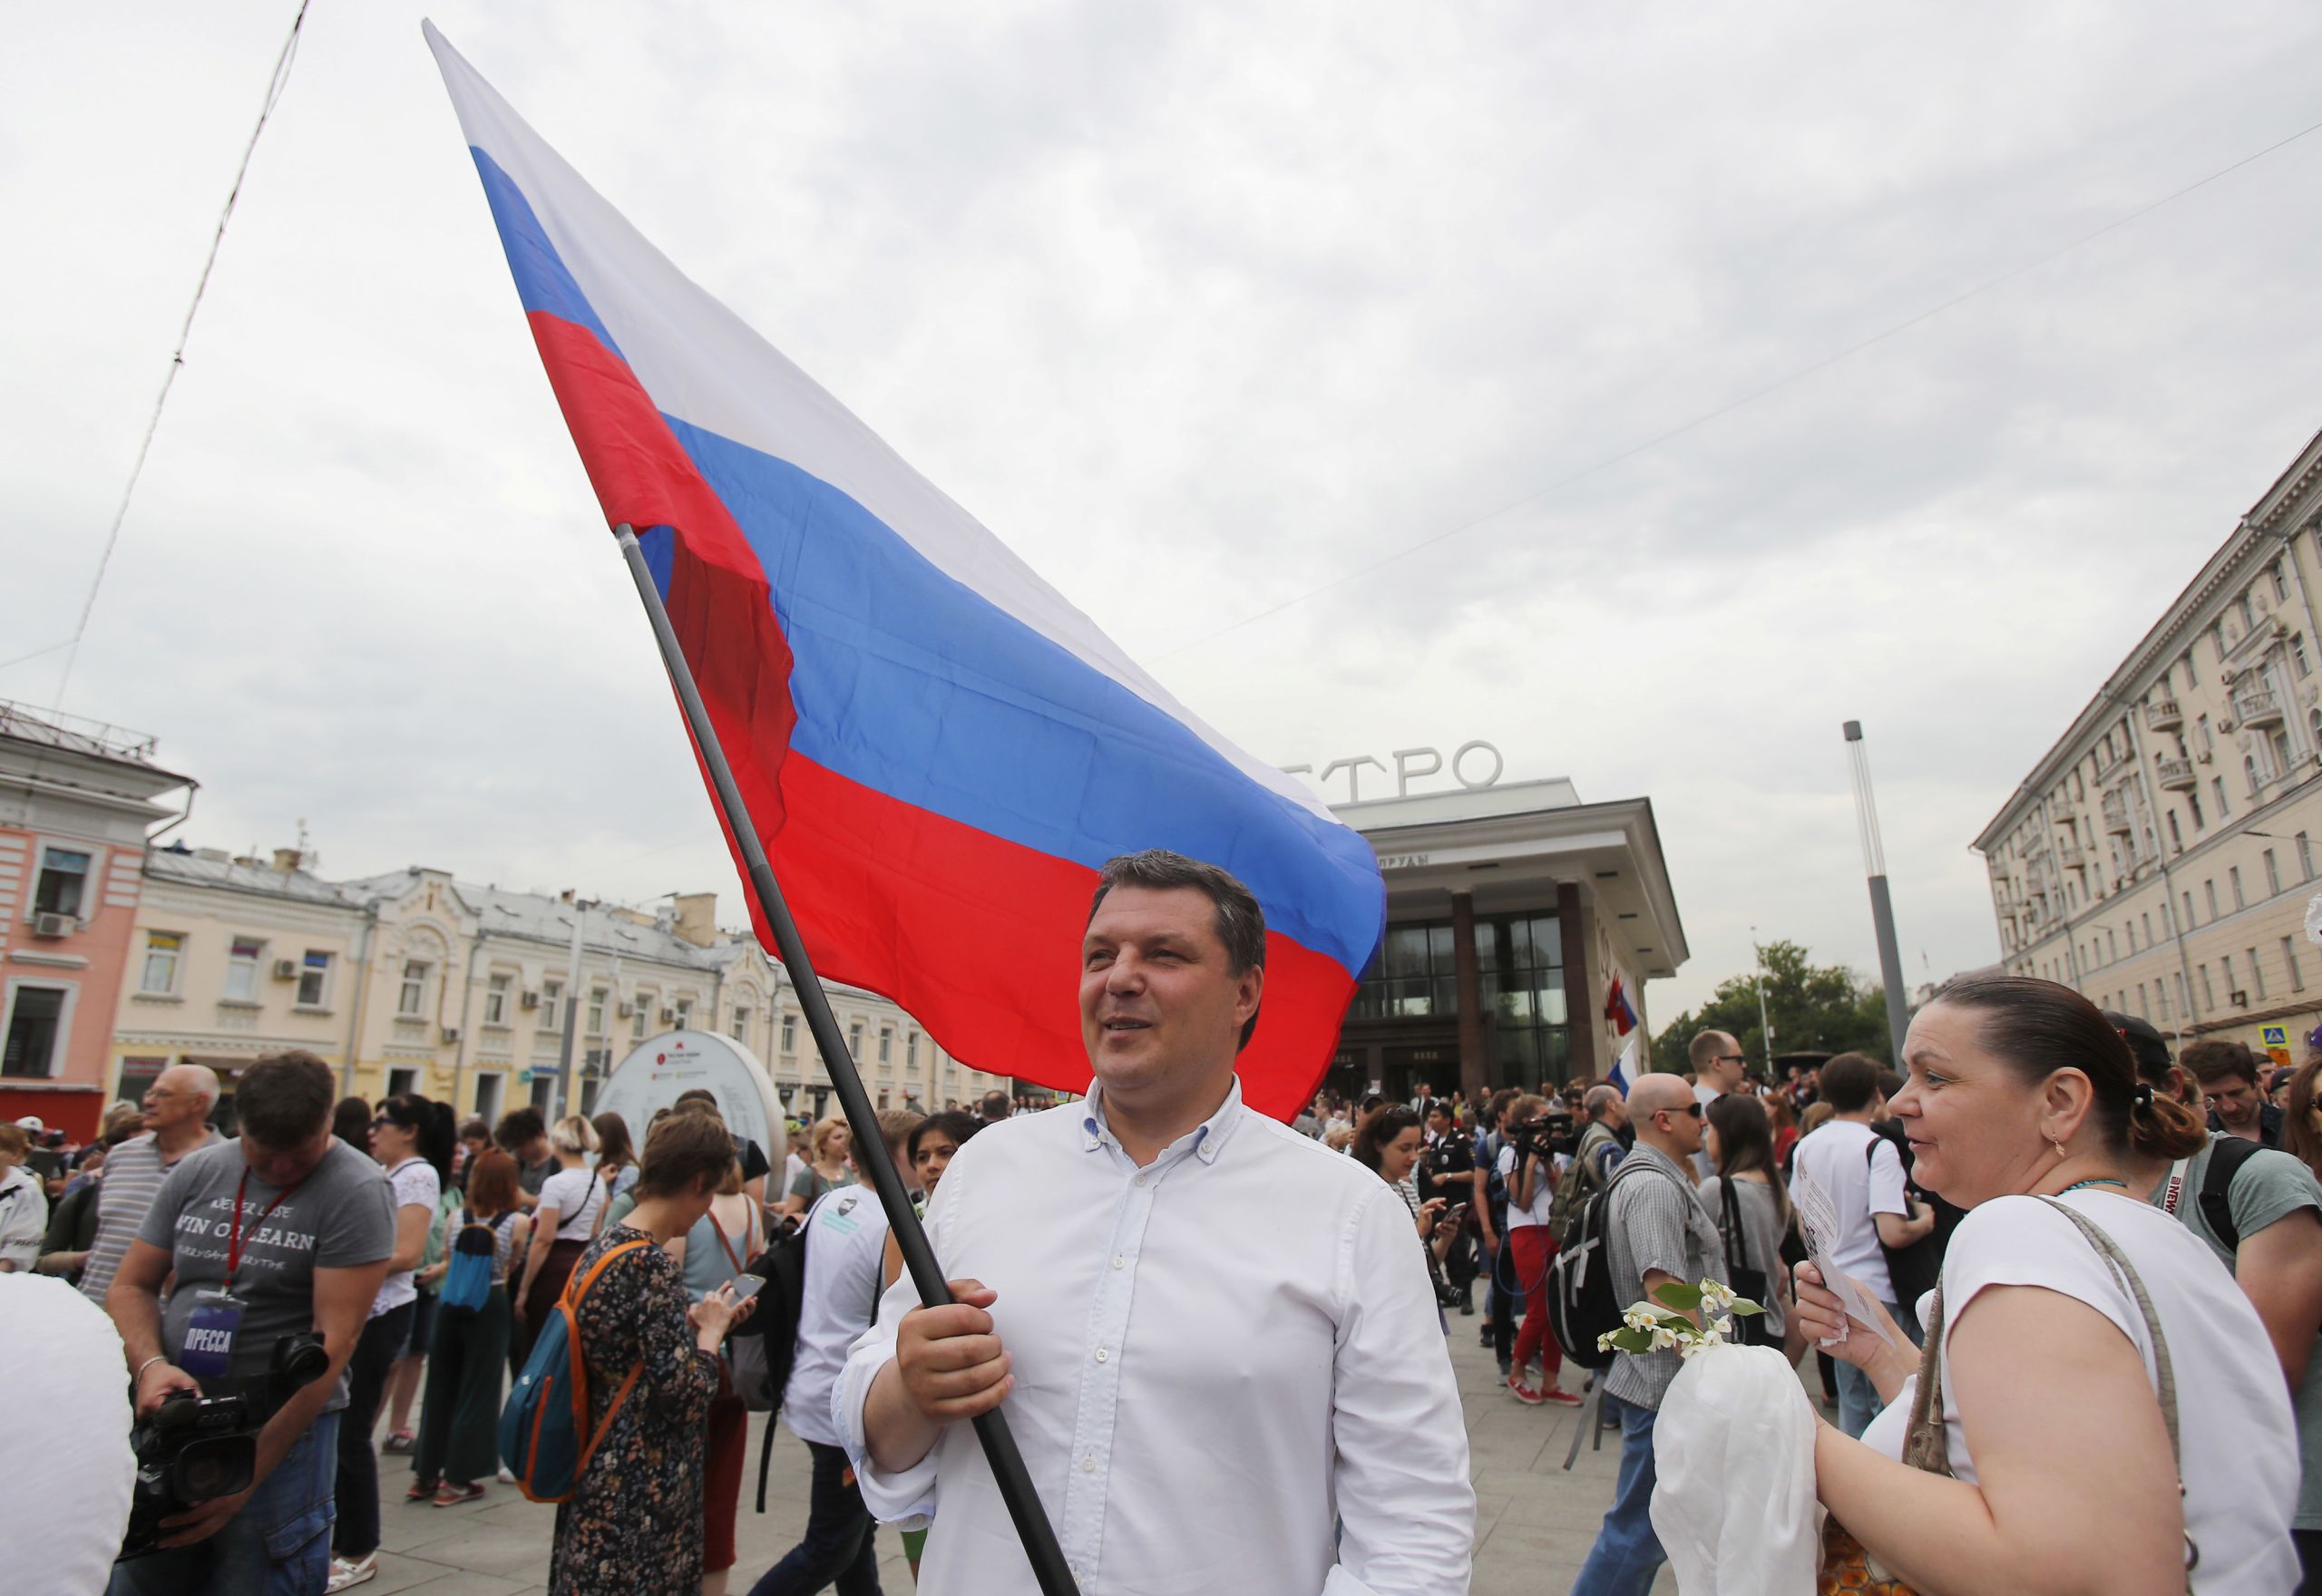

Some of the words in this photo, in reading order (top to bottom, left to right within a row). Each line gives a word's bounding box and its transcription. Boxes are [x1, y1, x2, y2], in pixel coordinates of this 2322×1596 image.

[1279, 739, 1503, 803] ТРО
[1379, 854, 1429, 868] ПРУДЫ
[258, 1205, 294, 1219] LSE
[184, 1328, 232, 1353] ПРЕССА
